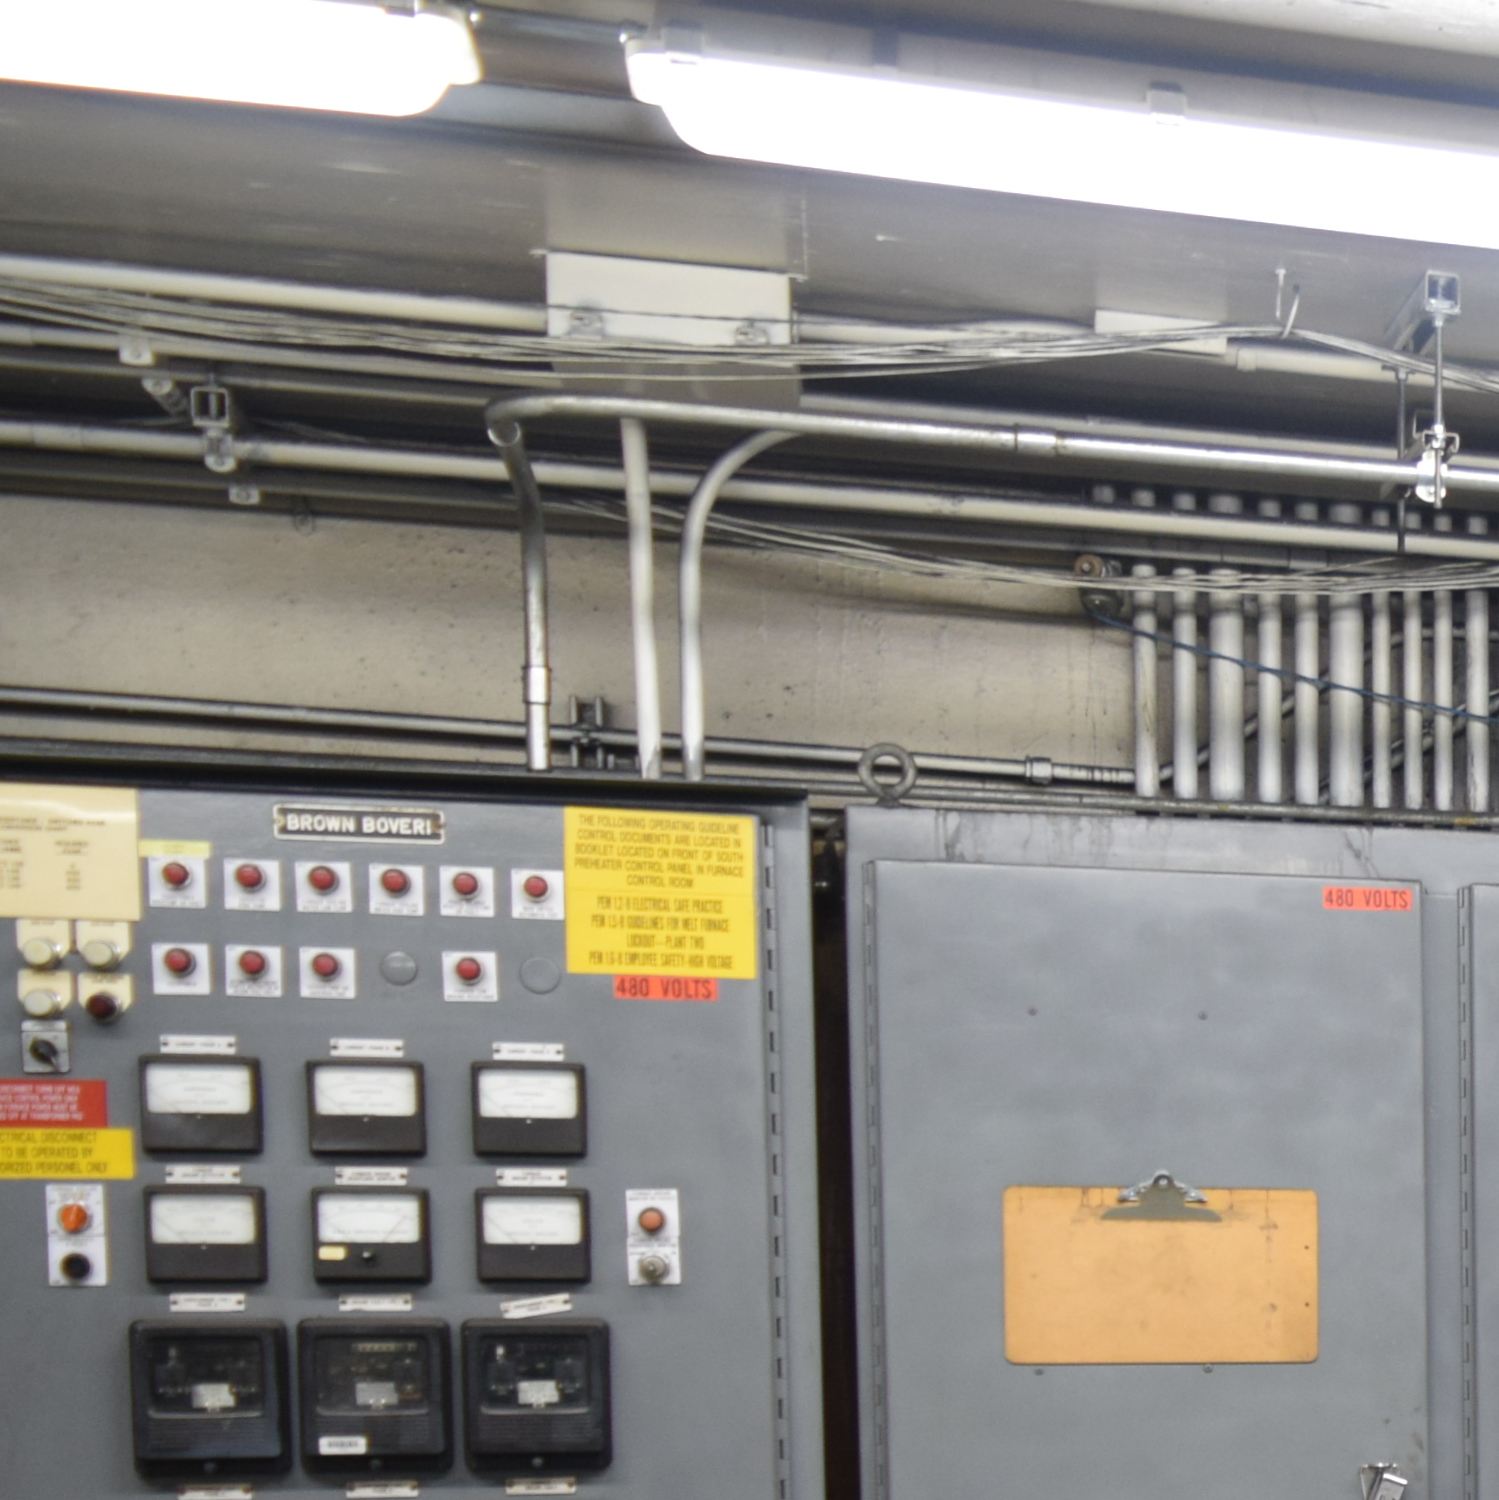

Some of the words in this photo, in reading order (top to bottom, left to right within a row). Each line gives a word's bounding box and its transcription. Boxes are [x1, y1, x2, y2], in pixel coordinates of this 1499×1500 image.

[287, 813, 355, 832] BROWN
[362, 816, 431, 835] BOVERI
[579, 814, 595, 826] THE
[598, 816, 645, 829] FOLLOWING
[649, 819, 695, 832] OPERATING
[699, 821, 738, 834] GUIDELINE
[578, 829, 617, 842] CONTROL
[620, 831, 670, 844] DOCUMENTS
[675, 834, 690, 846] ARE
[694, 836, 730, 848] LOCATED
[733, 838, 741, 848] IN
[575, 843, 613, 856] BOOKLET
[617, 846, 654, 858] LOCATED
[657, 848, 669, 858] ON
[672, 849, 698, 861] FRONT
[702, 850, 712, 860] OF
[717, 851, 743, 863] SOUTH
[575, 859, 622, 870] PREHEATER
[626, 861, 664, 873] CONTROL
[668, 863, 692, 875] PANEL
[707, 866, 744, 878] FURNACE
[627, 875, 665, 887] CONTROL
[669, 878, 693, 888] ROOM
[1325, 889, 1353, 906] 480
[1363, 890, 1407, 908] VOLTS
[617, 978, 649, 996] 480
[661, 978, 712, 999] VOLTS
[0, 1132, 36, 1143] CTRICAL
[41, 1133, 96, 1143] DISCONNECT
[16, 1147, 27, 1157] BE
[31, 1147, 78, 1158] OPERATED
[82, 1147, 92, 1157] BY
[0, 1162, 31, 1172] ORIZED
[86, 1163, 107, 1173] ONLY
